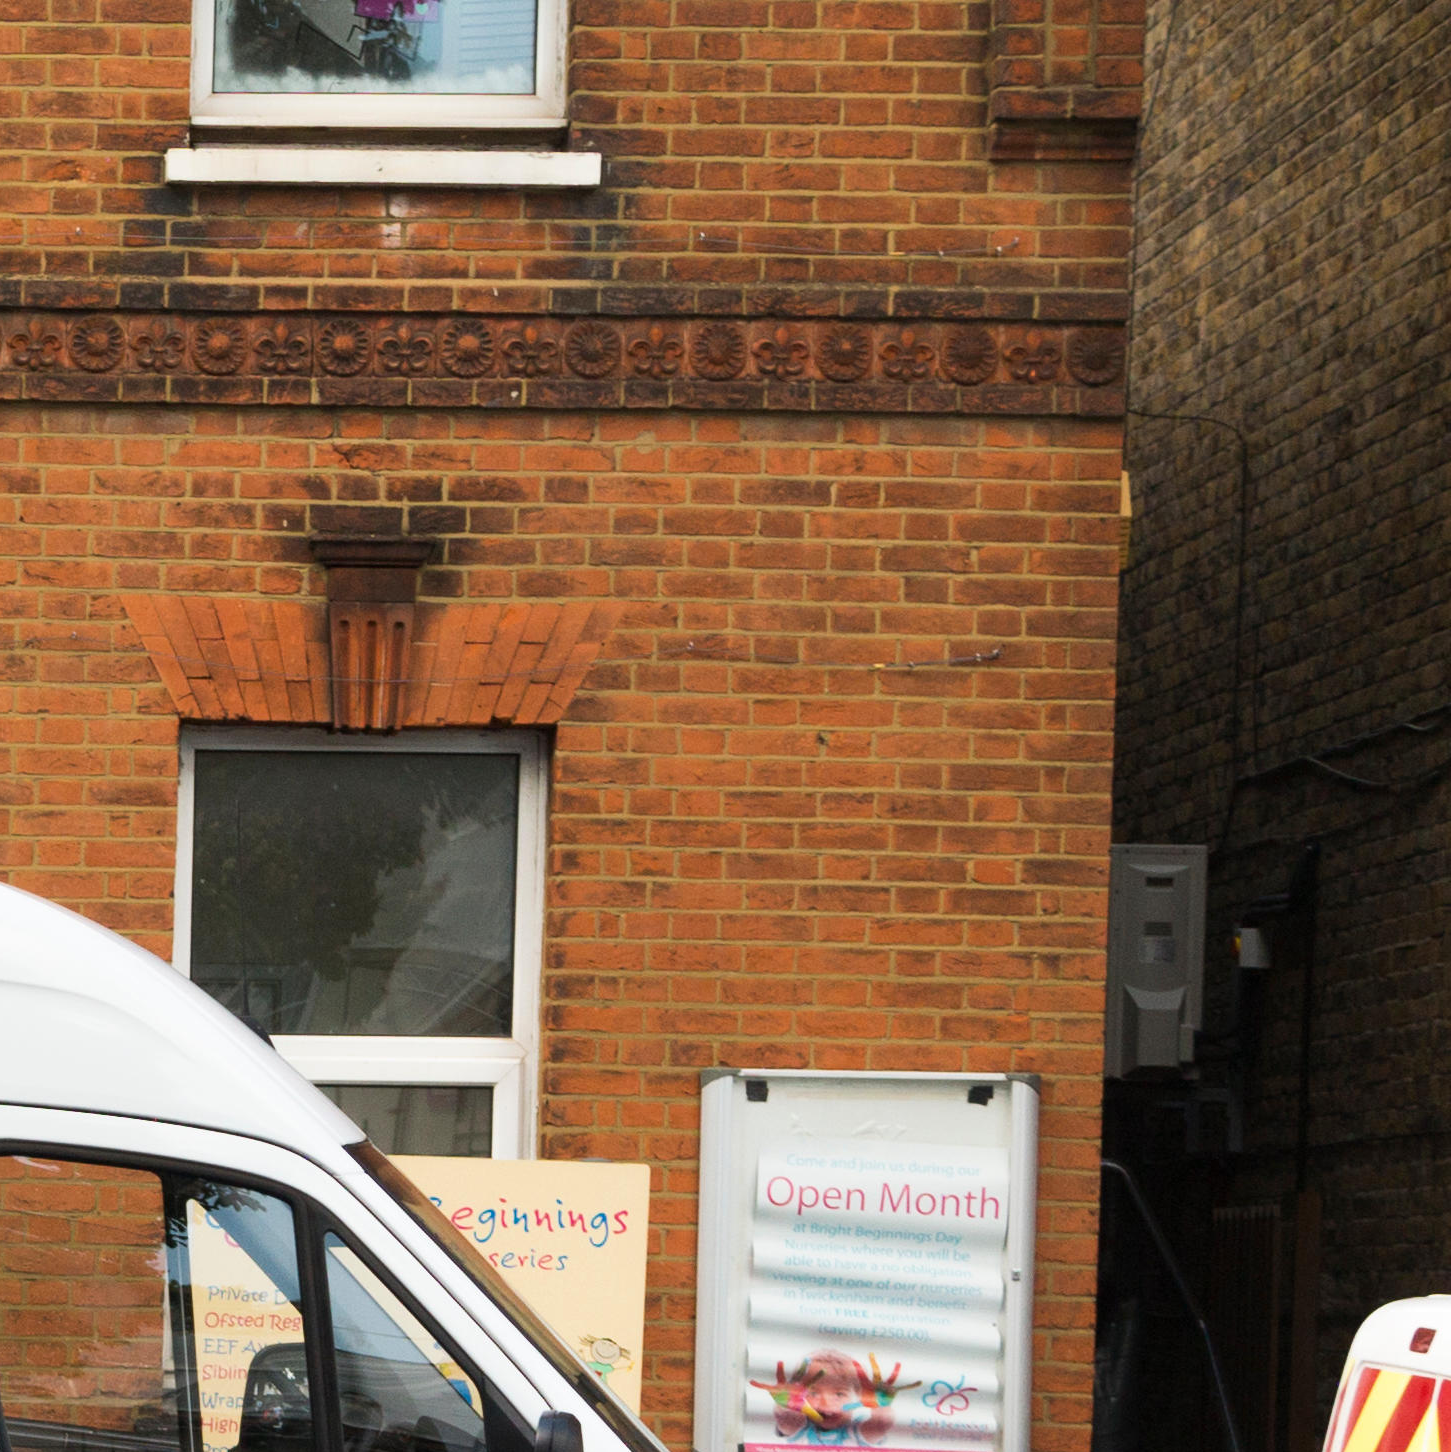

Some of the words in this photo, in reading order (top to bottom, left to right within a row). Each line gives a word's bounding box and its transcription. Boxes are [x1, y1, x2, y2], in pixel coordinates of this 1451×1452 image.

[767, 1176, 866, 1216] Open
[879, 1182, 1000, 1220] Month
[204, 1311, 265, 1329] Ofsted
